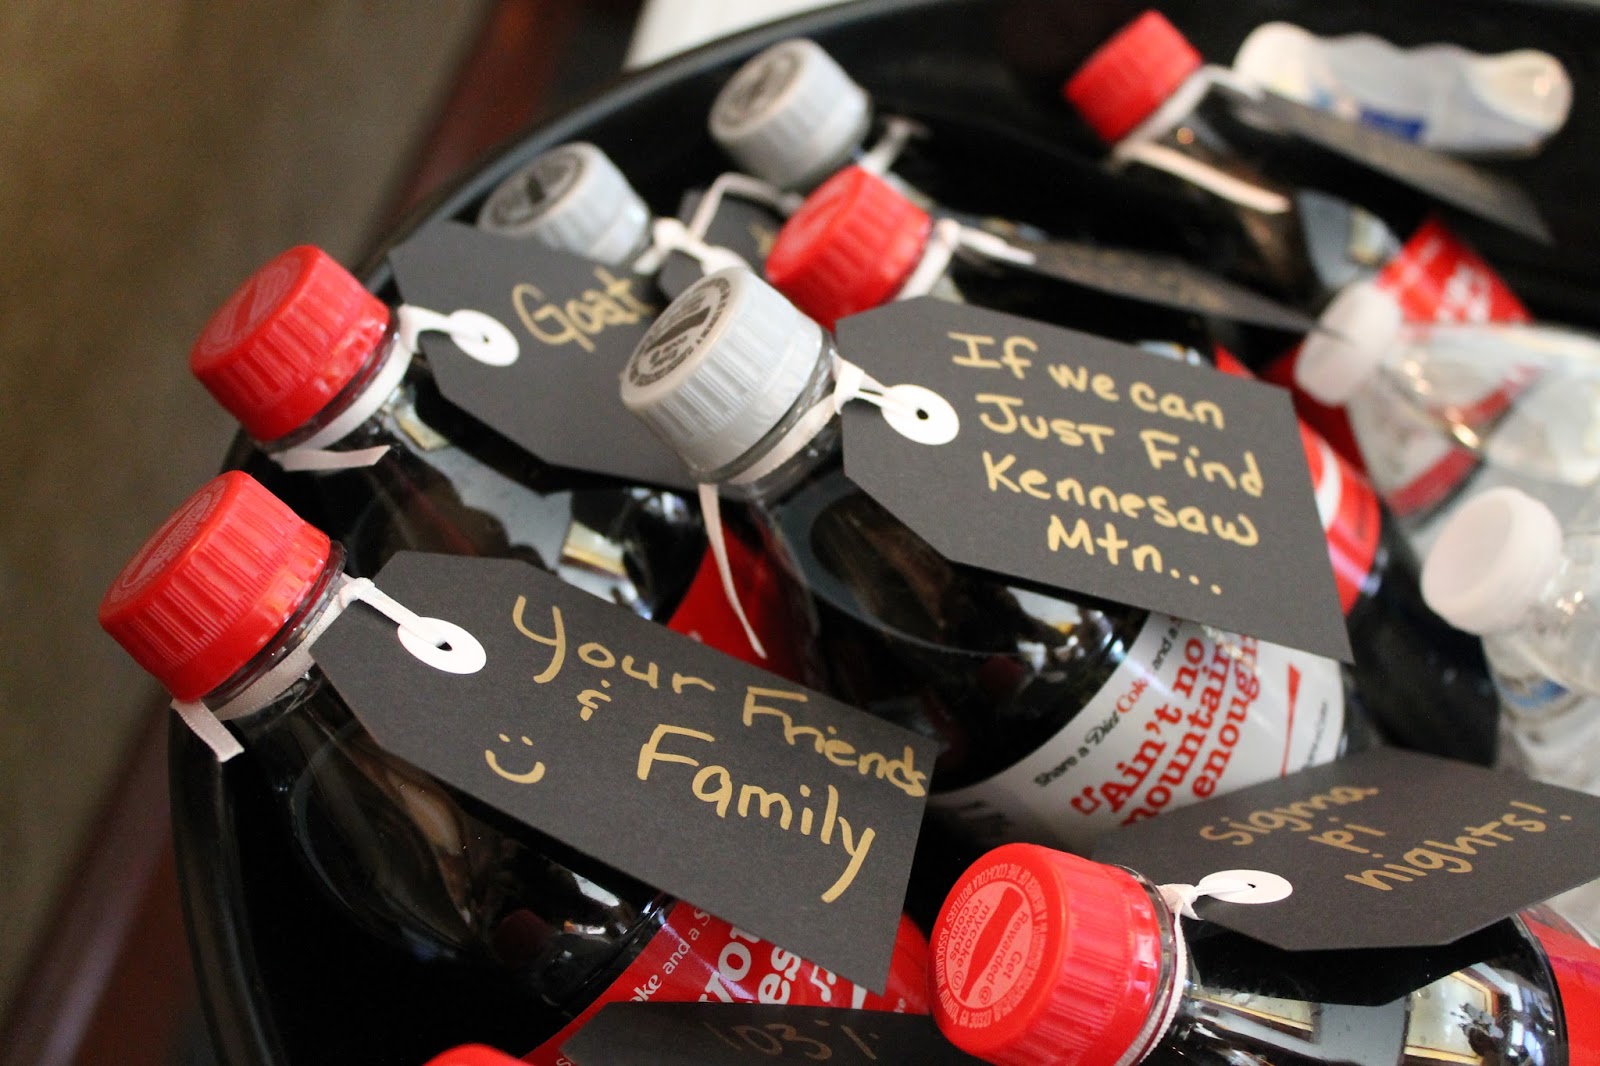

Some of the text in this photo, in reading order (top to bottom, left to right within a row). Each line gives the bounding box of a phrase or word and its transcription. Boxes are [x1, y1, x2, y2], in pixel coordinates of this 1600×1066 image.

[512, 264, 655, 353] Goat
[949, 332, 1223, 430] If we can
[982, 450, 1260, 548] Kennesaw
[1139, 428, 1264, 498] Find
[1046, 514, 1222, 596] Mtn...
[1084, 711, 1120, 745] Diet
[1152, 636, 1173, 670] and
[1172, 637, 1205, 699] no
[742, 686, 928, 798] Friends
[636, 723, 877, 905] Family
[662, 939, 692, 975] and
[688, 927, 701, 941] a
[949, 898, 984, 961] rewards
[957, 905, 991, 969] mycoke
[986, 910, 1029, 985] Rewarded
[1003, 951, 1023, 979] Get
